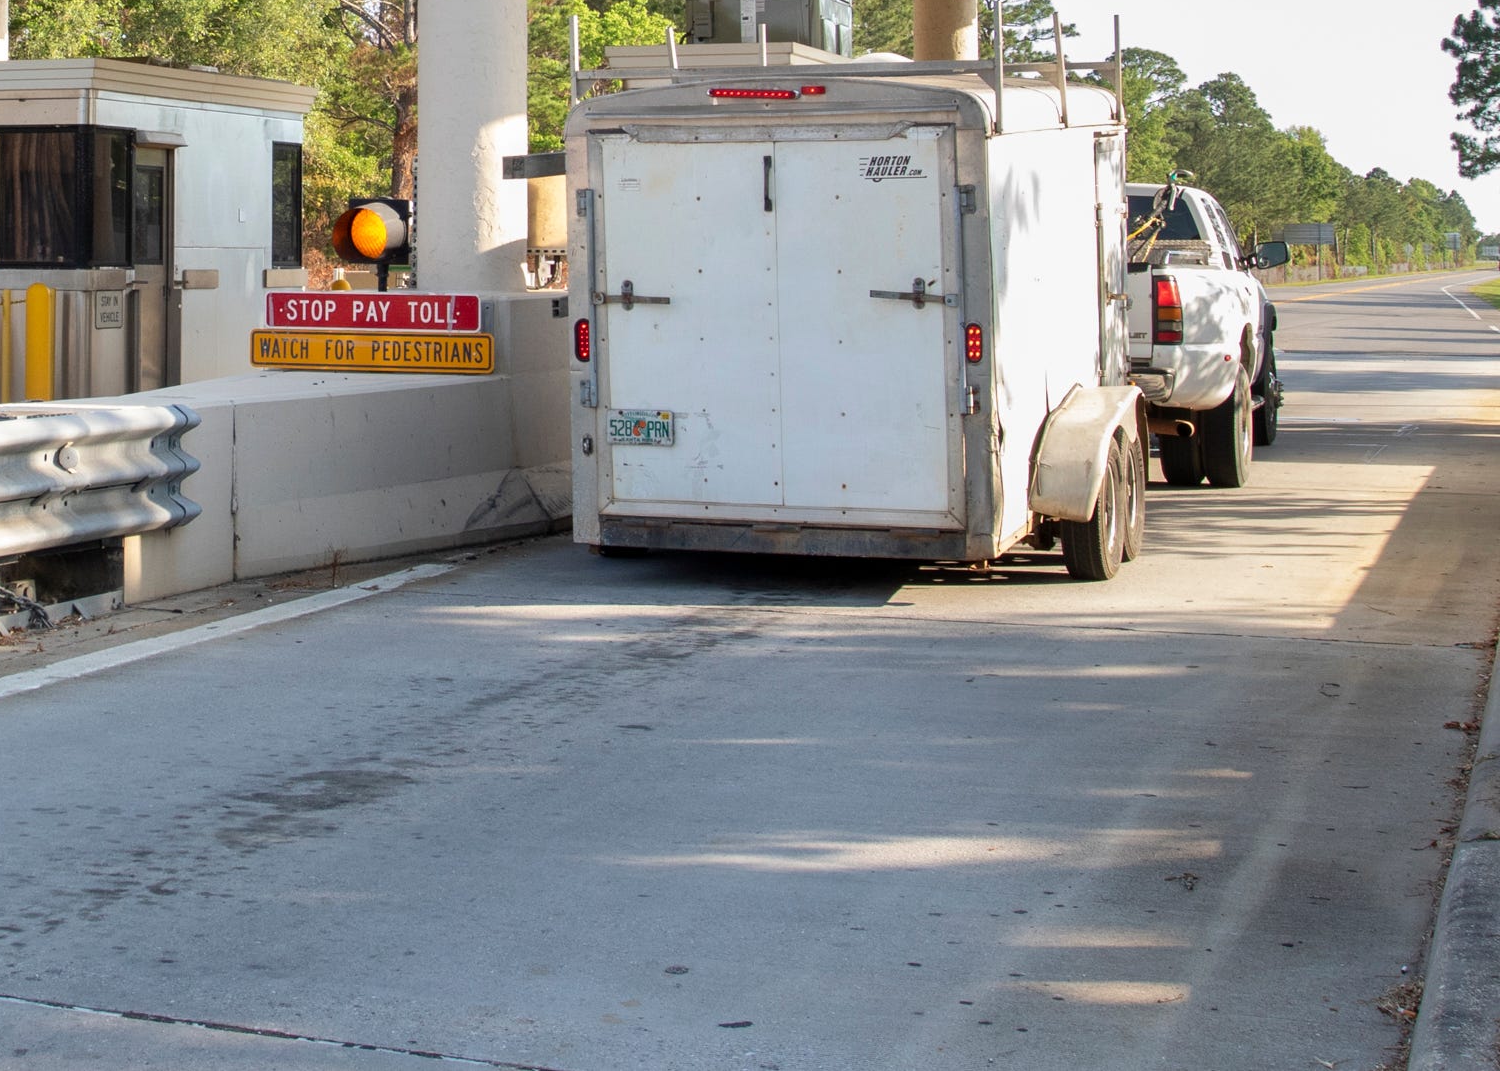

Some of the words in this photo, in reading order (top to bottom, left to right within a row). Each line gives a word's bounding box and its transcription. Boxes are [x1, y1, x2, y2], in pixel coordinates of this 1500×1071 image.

[869, 155, 911, 167] HORTON
[286, 299, 337, 322] STOP
[352, 301, 391, 323] PAY
[408, 301, 458, 324] TOLL
[260, 337, 309, 360] WATCH
[325, 339, 355, 361] FOR
[371, 340, 484, 364] PEDESTRIANS
[610, 419, 633, 437] 528
[647, 420, 670, 438] PRN
